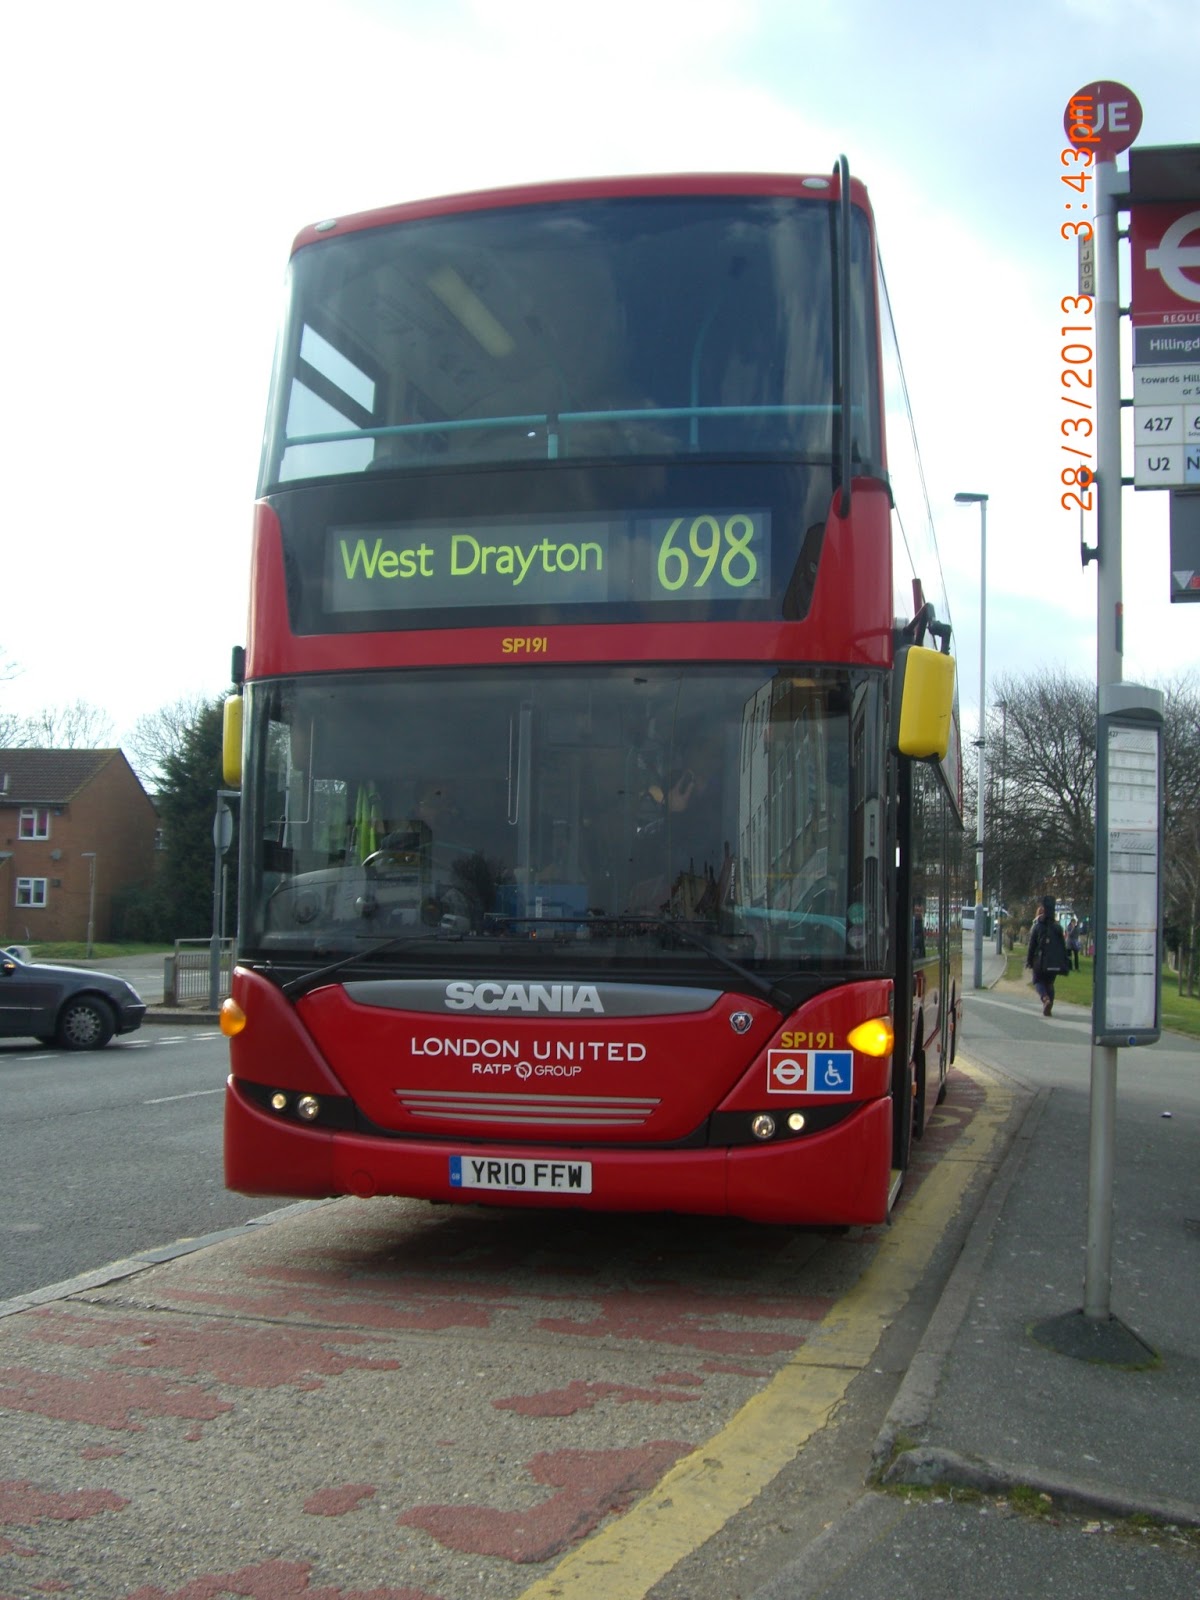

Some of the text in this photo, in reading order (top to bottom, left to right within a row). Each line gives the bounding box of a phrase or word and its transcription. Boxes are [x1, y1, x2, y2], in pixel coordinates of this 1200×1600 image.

[1141, 375, 1180, 385] towards
[1144, 416, 1173, 431] 427
[1148, 456, 1170, 471] U2
[340, 514, 758, 591] West Drayton 698
[502, 637, 548, 653] SP191
[444, 982, 605, 1013] SCANIA
[781, 1032, 834, 1048] SP191
[411, 1037, 647, 1062] LONDON UNITED
[472, 1063, 582, 1078] RATP GROUP
[471, 1160, 583, 1188] YR10 FFW
